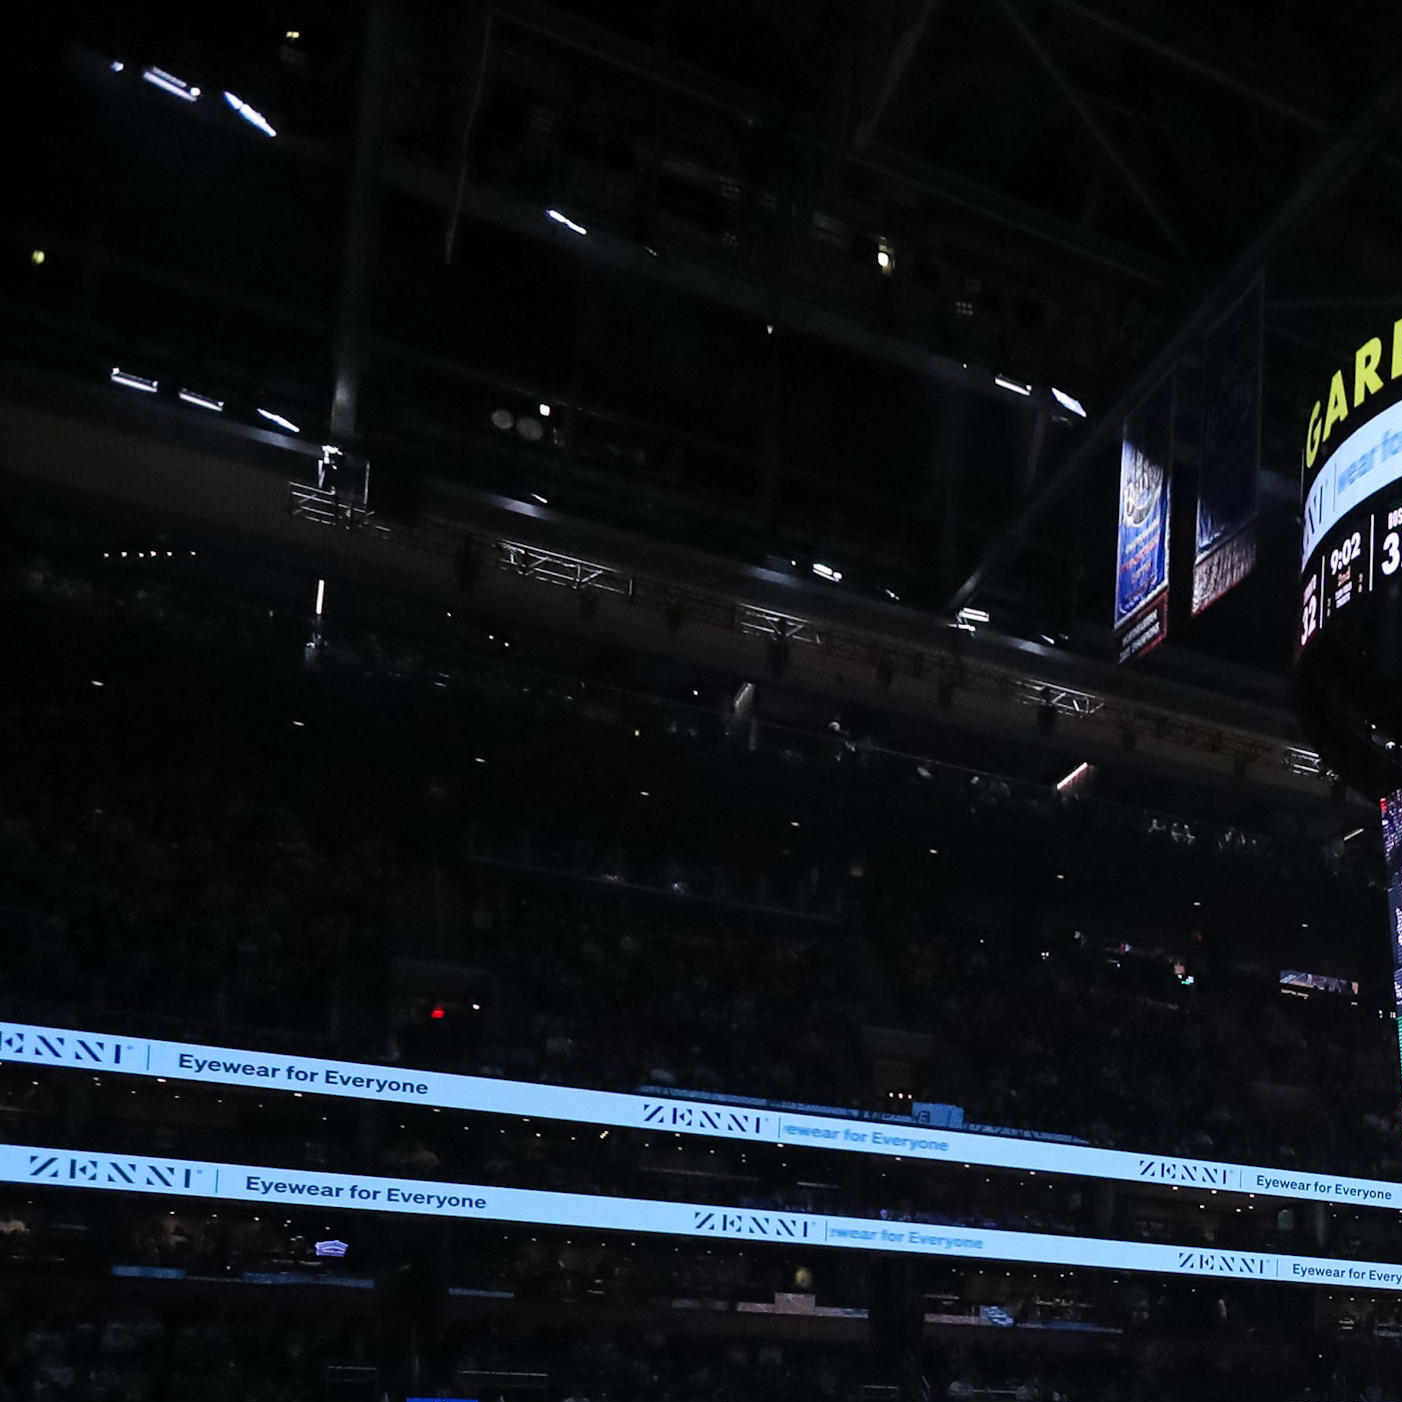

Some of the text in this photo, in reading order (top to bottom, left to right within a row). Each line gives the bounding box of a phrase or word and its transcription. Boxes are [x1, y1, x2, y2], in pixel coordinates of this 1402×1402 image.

[1330, 531, 1361, 576] 9:02
[1301, 594, 1317, 646] 32
[179, 1053, 429, 1096] Eyewear for Everyone
[643, 1104, 949, 1152] ZENNI for Everyone
[30, 1156, 487, 1212] ZENNI Eyewear for Everyone
[1139, 1160, 1392, 1201] ZENNI Eyewear for Everyone
[694, 1212, 983, 1249] ZENNI for Everyone
[1179, 1252, 1264, 1274] ZENNI
[1292, 1262, 1345, 1279] Eyewear
[1348, 1268, 1366, 1280] for
